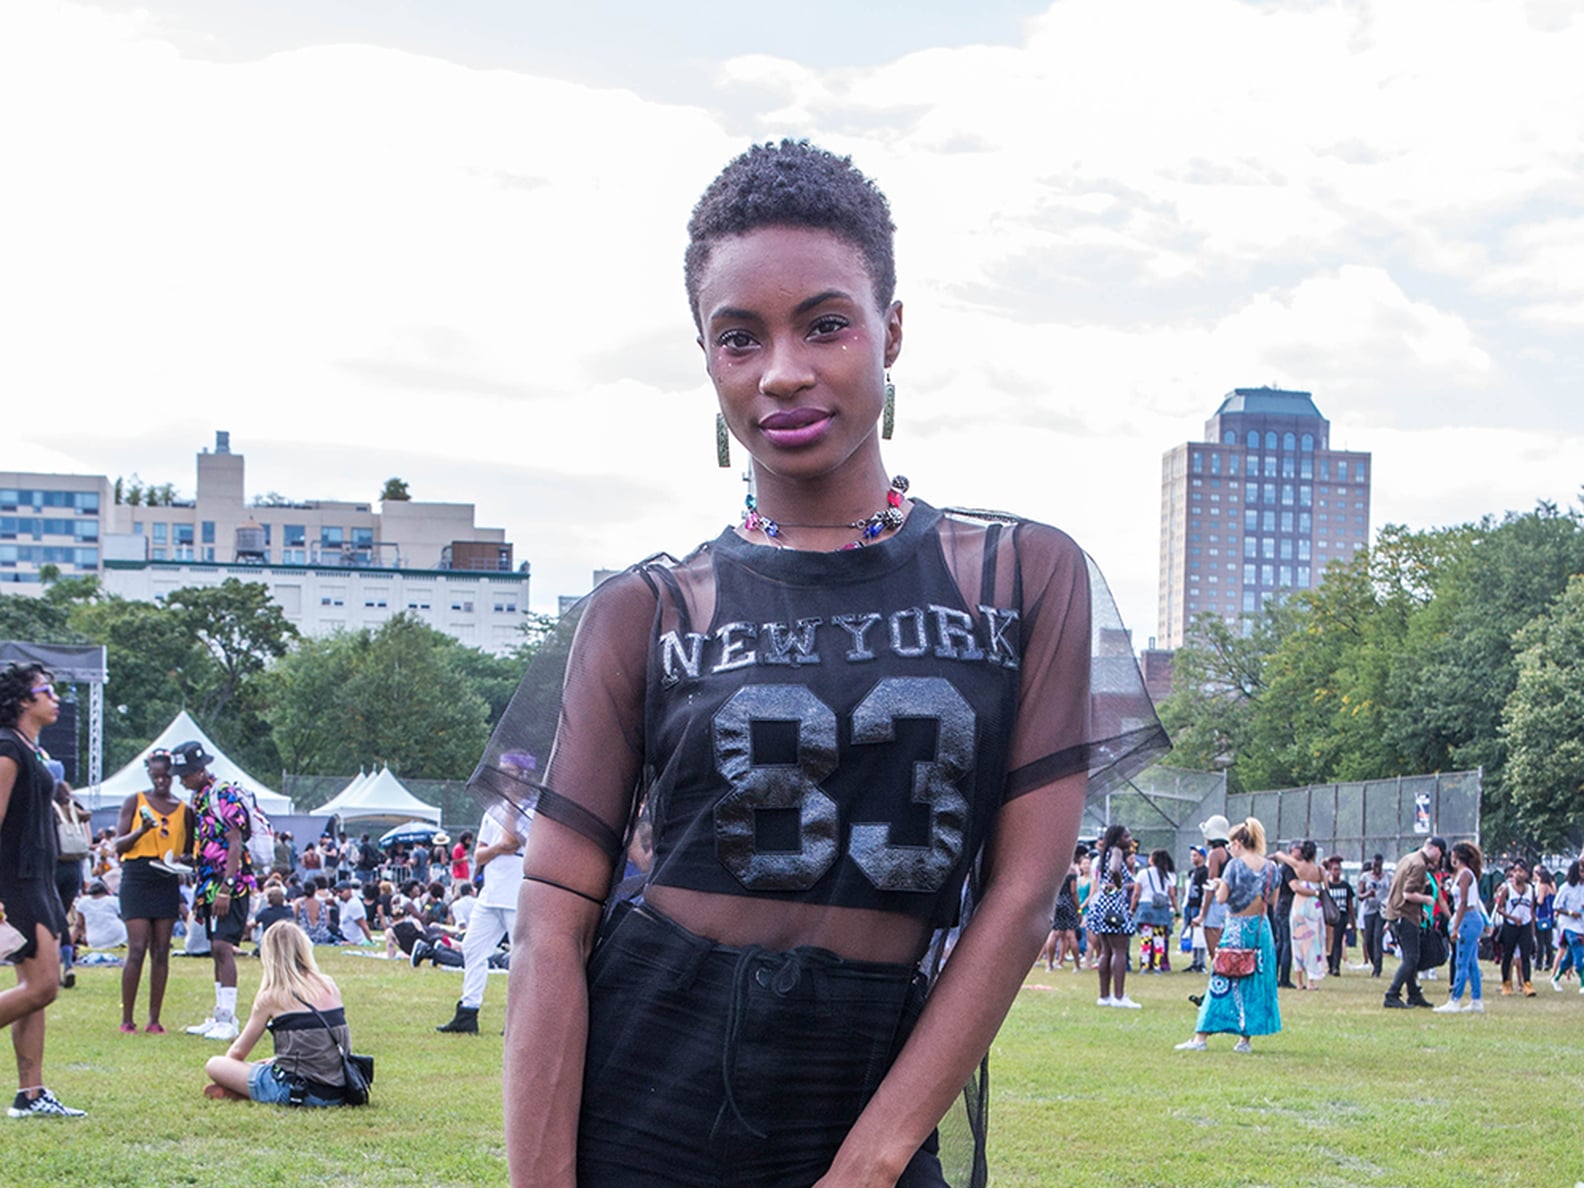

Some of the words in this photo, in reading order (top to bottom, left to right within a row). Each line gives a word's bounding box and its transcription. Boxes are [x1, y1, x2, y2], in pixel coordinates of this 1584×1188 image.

[659, 617, 823, 690] NEW
[831, 604, 1021, 670] YORK
[711, 677, 977, 892] 83
